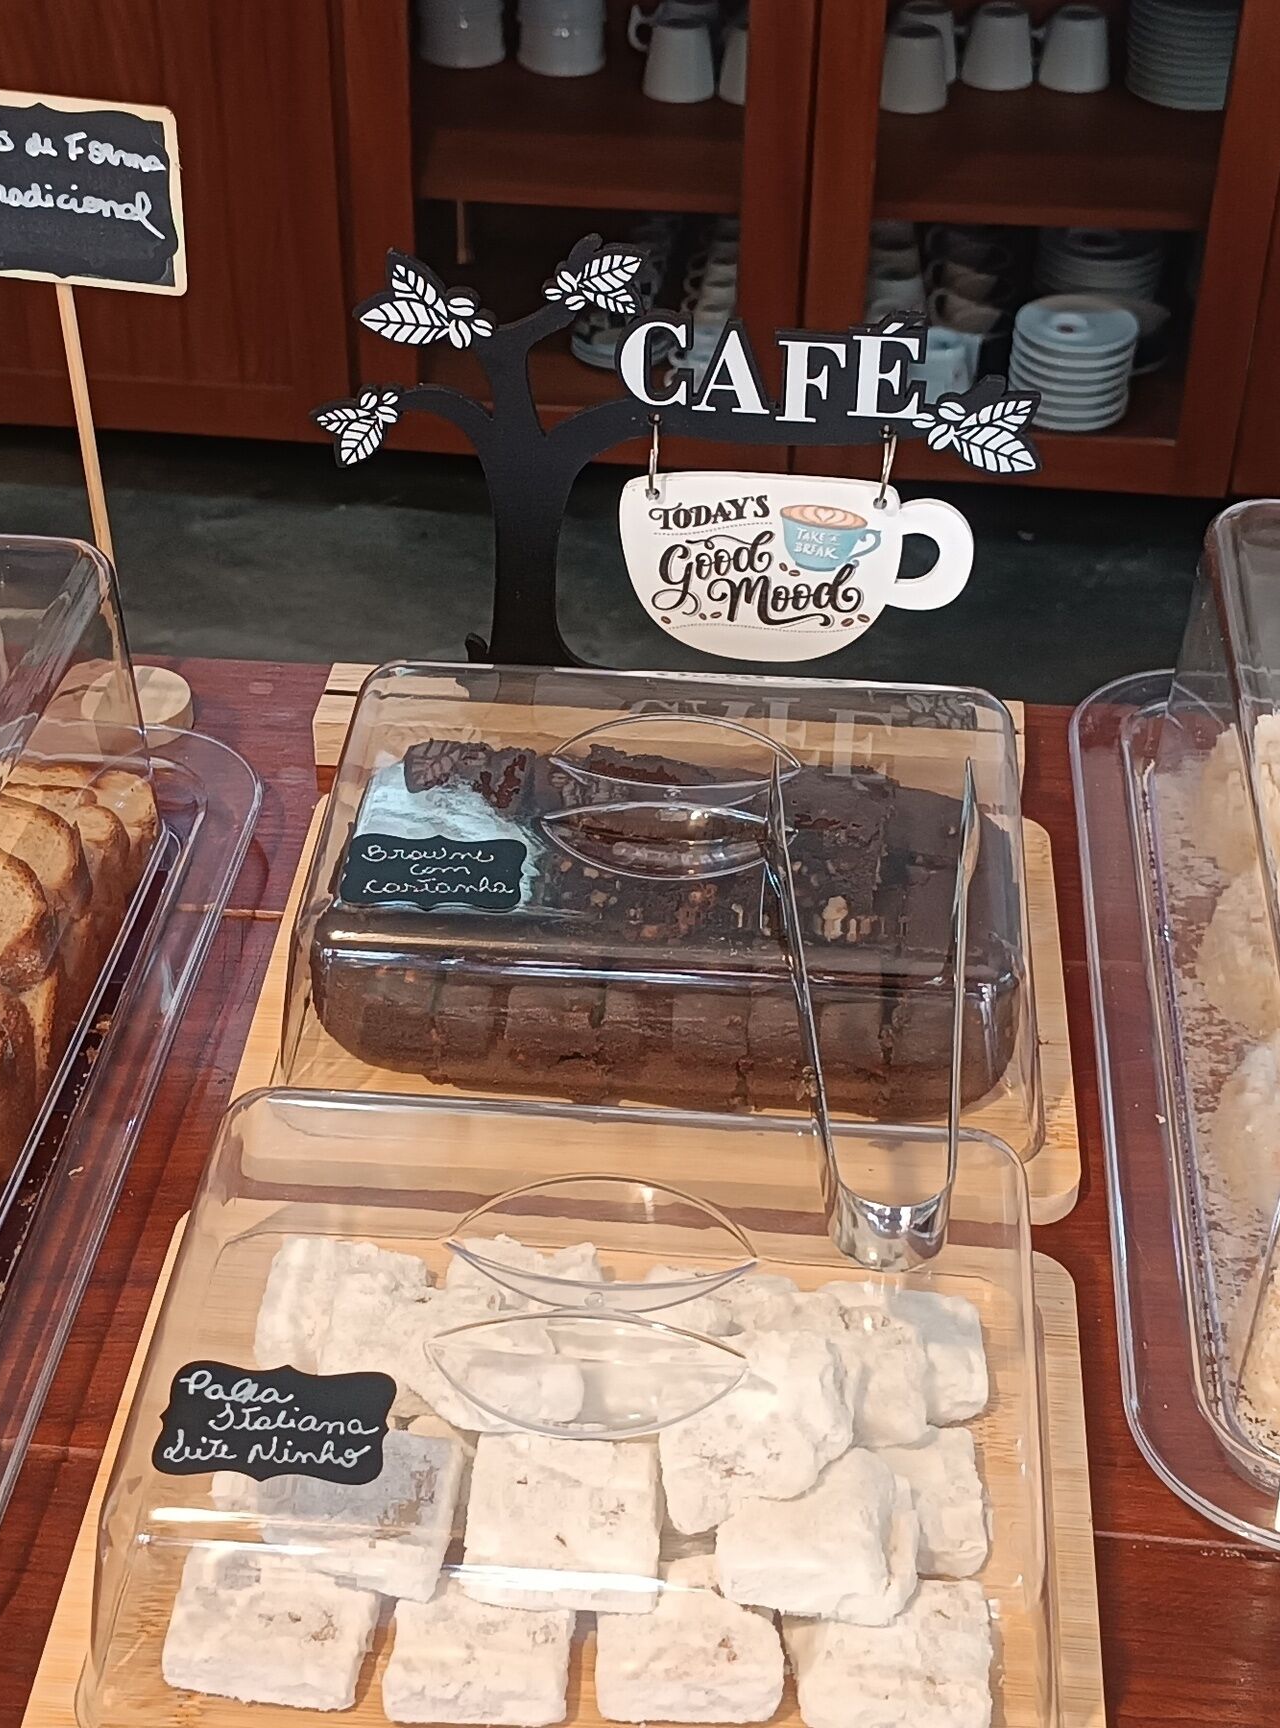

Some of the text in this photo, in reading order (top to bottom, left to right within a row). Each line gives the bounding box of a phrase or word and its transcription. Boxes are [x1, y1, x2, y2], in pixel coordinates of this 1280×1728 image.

[621, 321, 922, 424] CAFÉ
[649, 495, 770, 530] TODAY'S
[793, 542, 839, 560] BREAK
[796, 527, 826, 544] TAKE
[651, 530, 776, 616] Good
[707, 562, 864, 628] Mood
[209, 1403, 379, 1435] Italiana
[247, 1436, 371, 1468] Ninho
